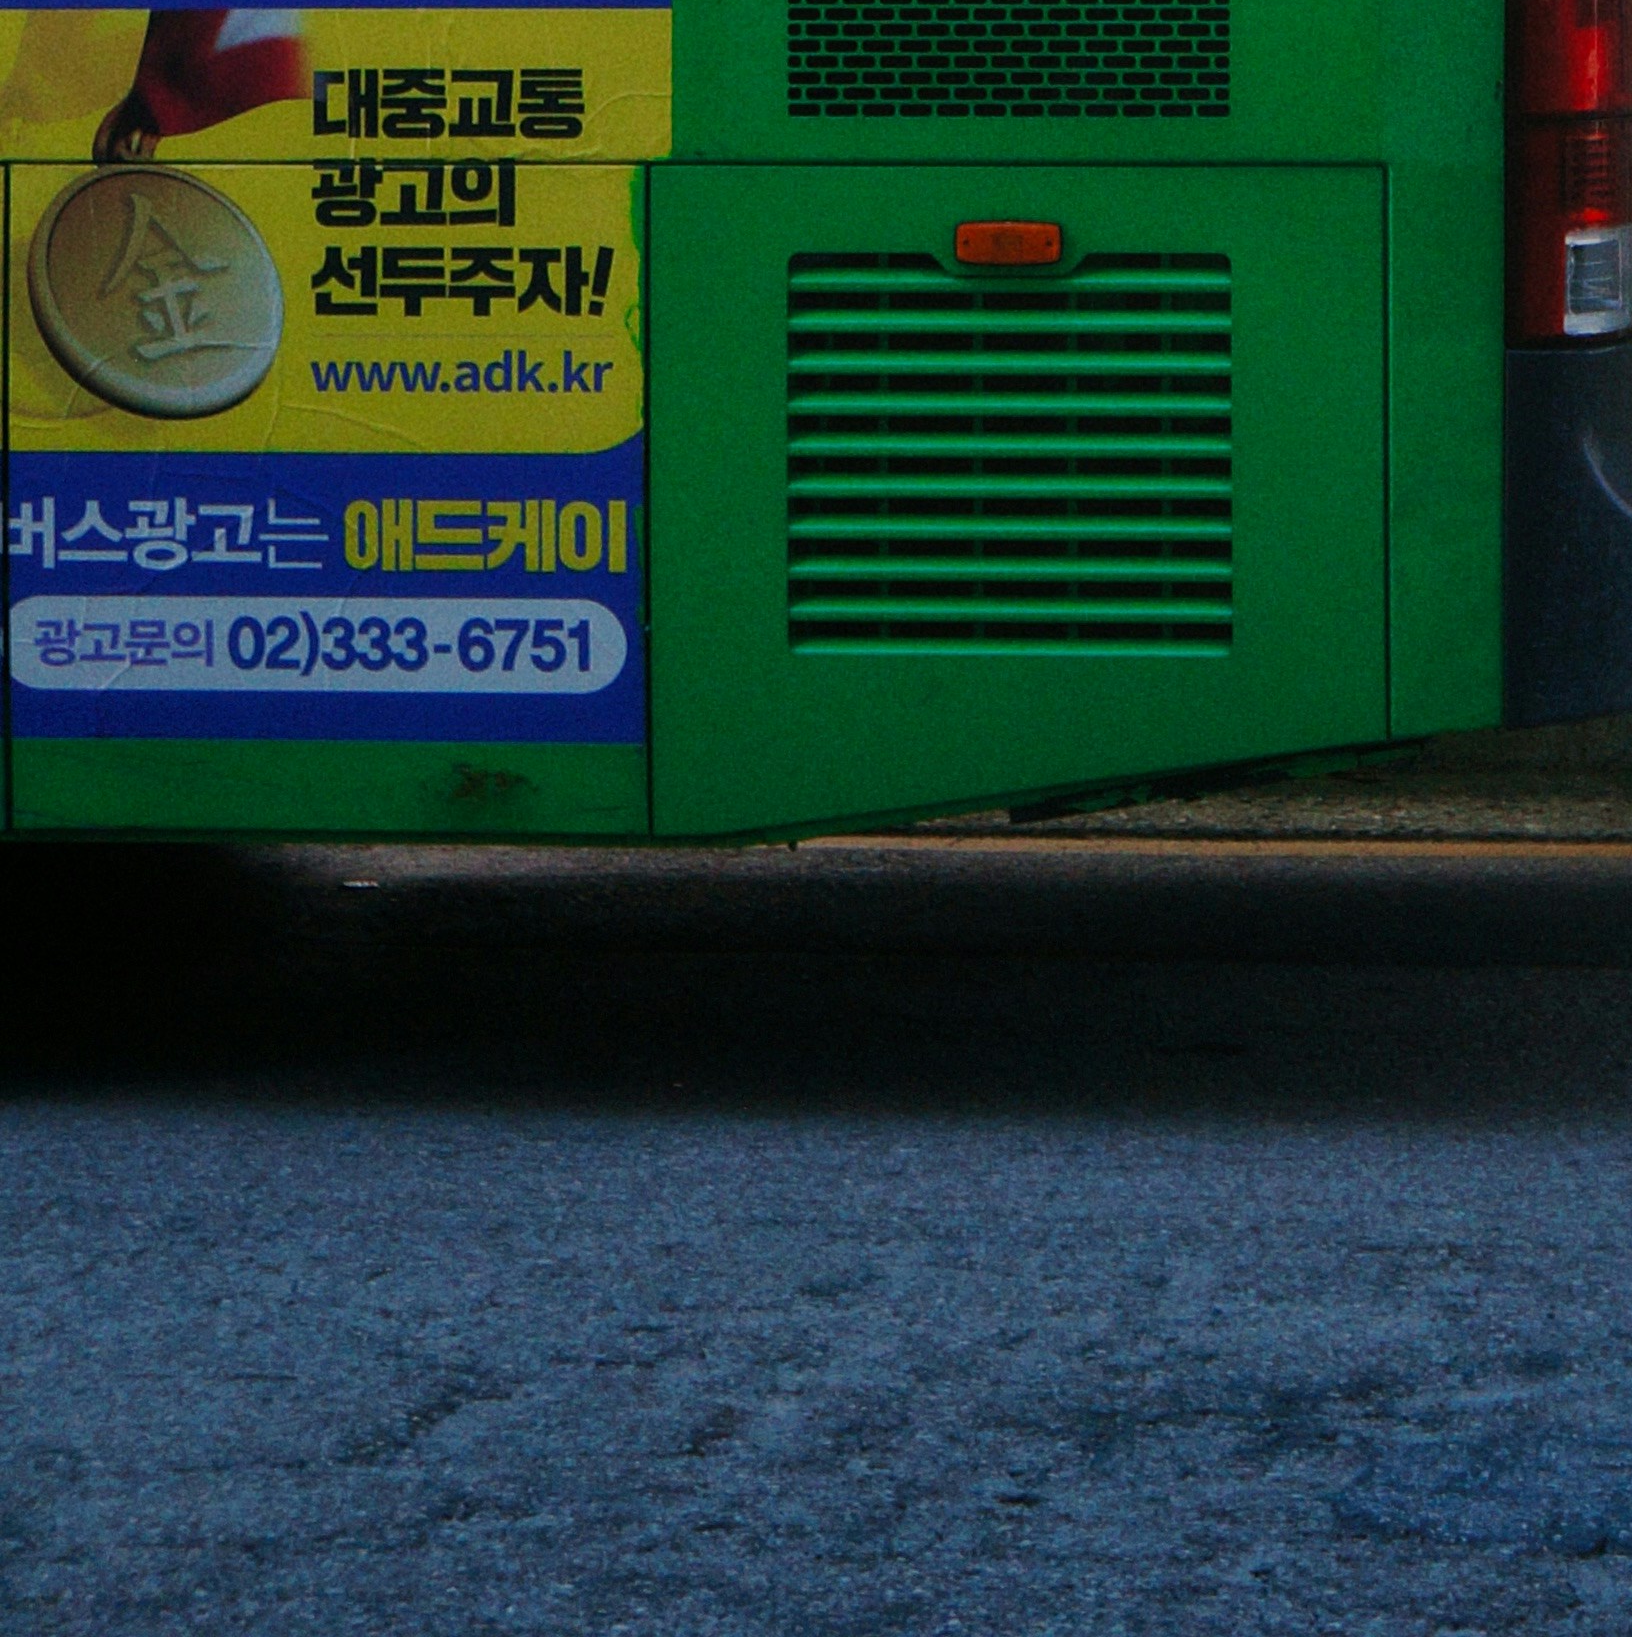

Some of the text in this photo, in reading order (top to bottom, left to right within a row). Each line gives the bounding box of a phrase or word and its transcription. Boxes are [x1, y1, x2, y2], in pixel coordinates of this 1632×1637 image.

[312, 68, 586, 140] 대중교통
[310, 157, 517, 227] 광고의
[310, 245, 615, 317] 선두주자!
[310, 349, 613, 394] www.adk.kr
[0, 496, 628, 573] 버스광고는 애드케이
[34, 612, 593, 676] 광고문의 02)333-6751
